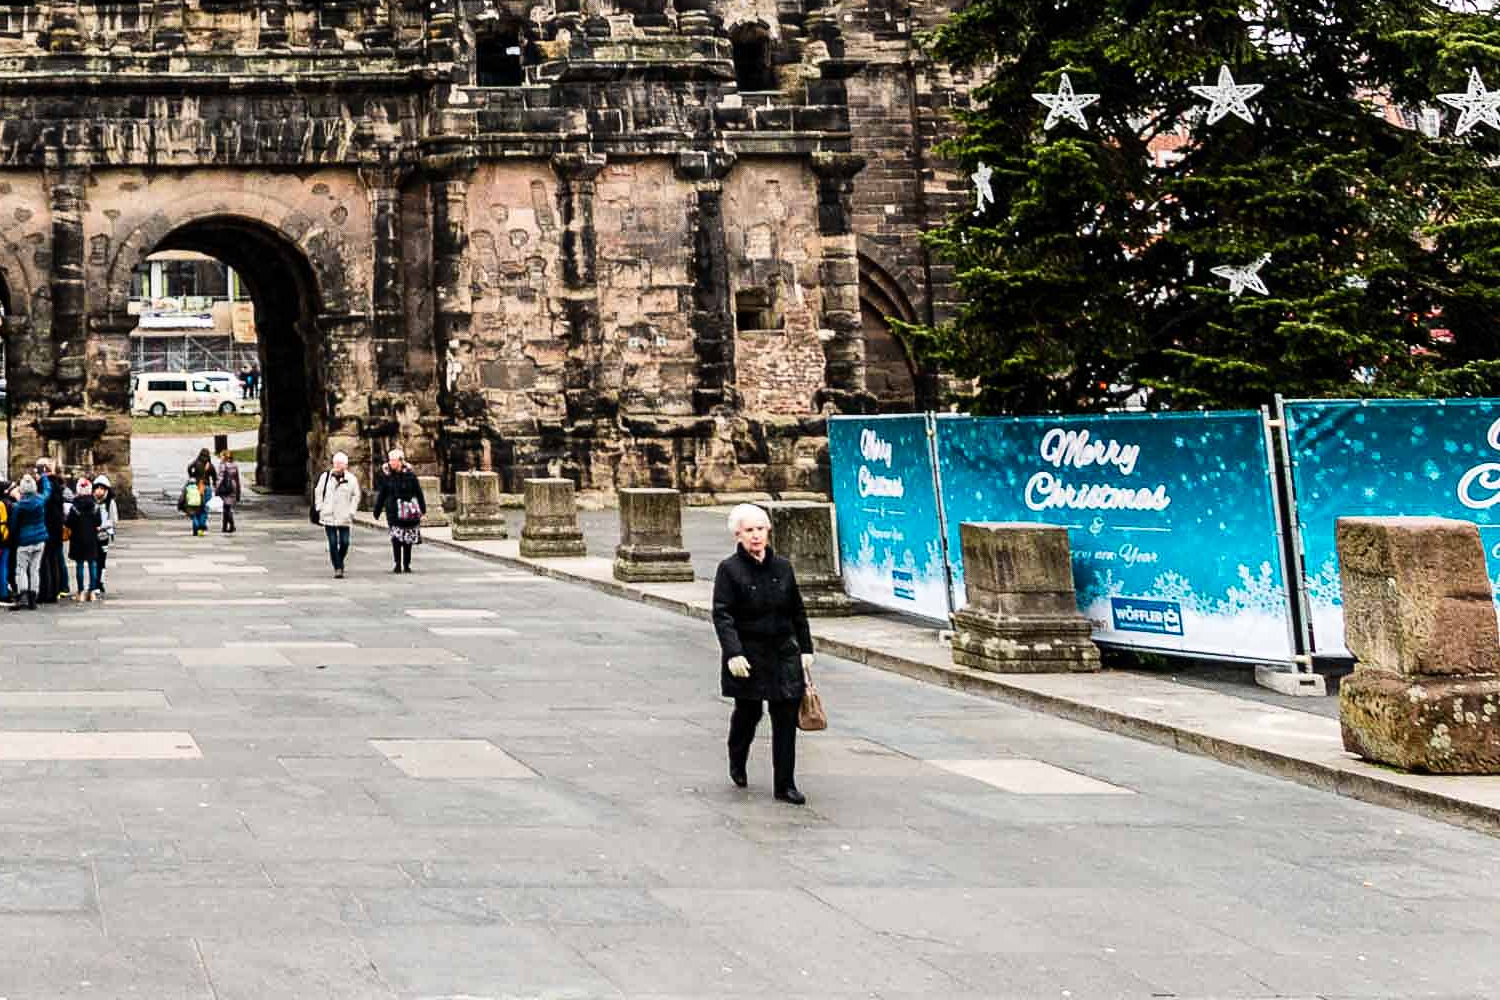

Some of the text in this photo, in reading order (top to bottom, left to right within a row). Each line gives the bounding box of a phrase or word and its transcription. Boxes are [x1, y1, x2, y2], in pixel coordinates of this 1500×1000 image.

[1040, 428, 1140, 475] Merry
[1024, 471, 1171, 511] Christmas
[1089, 516, 1105, 535] &
